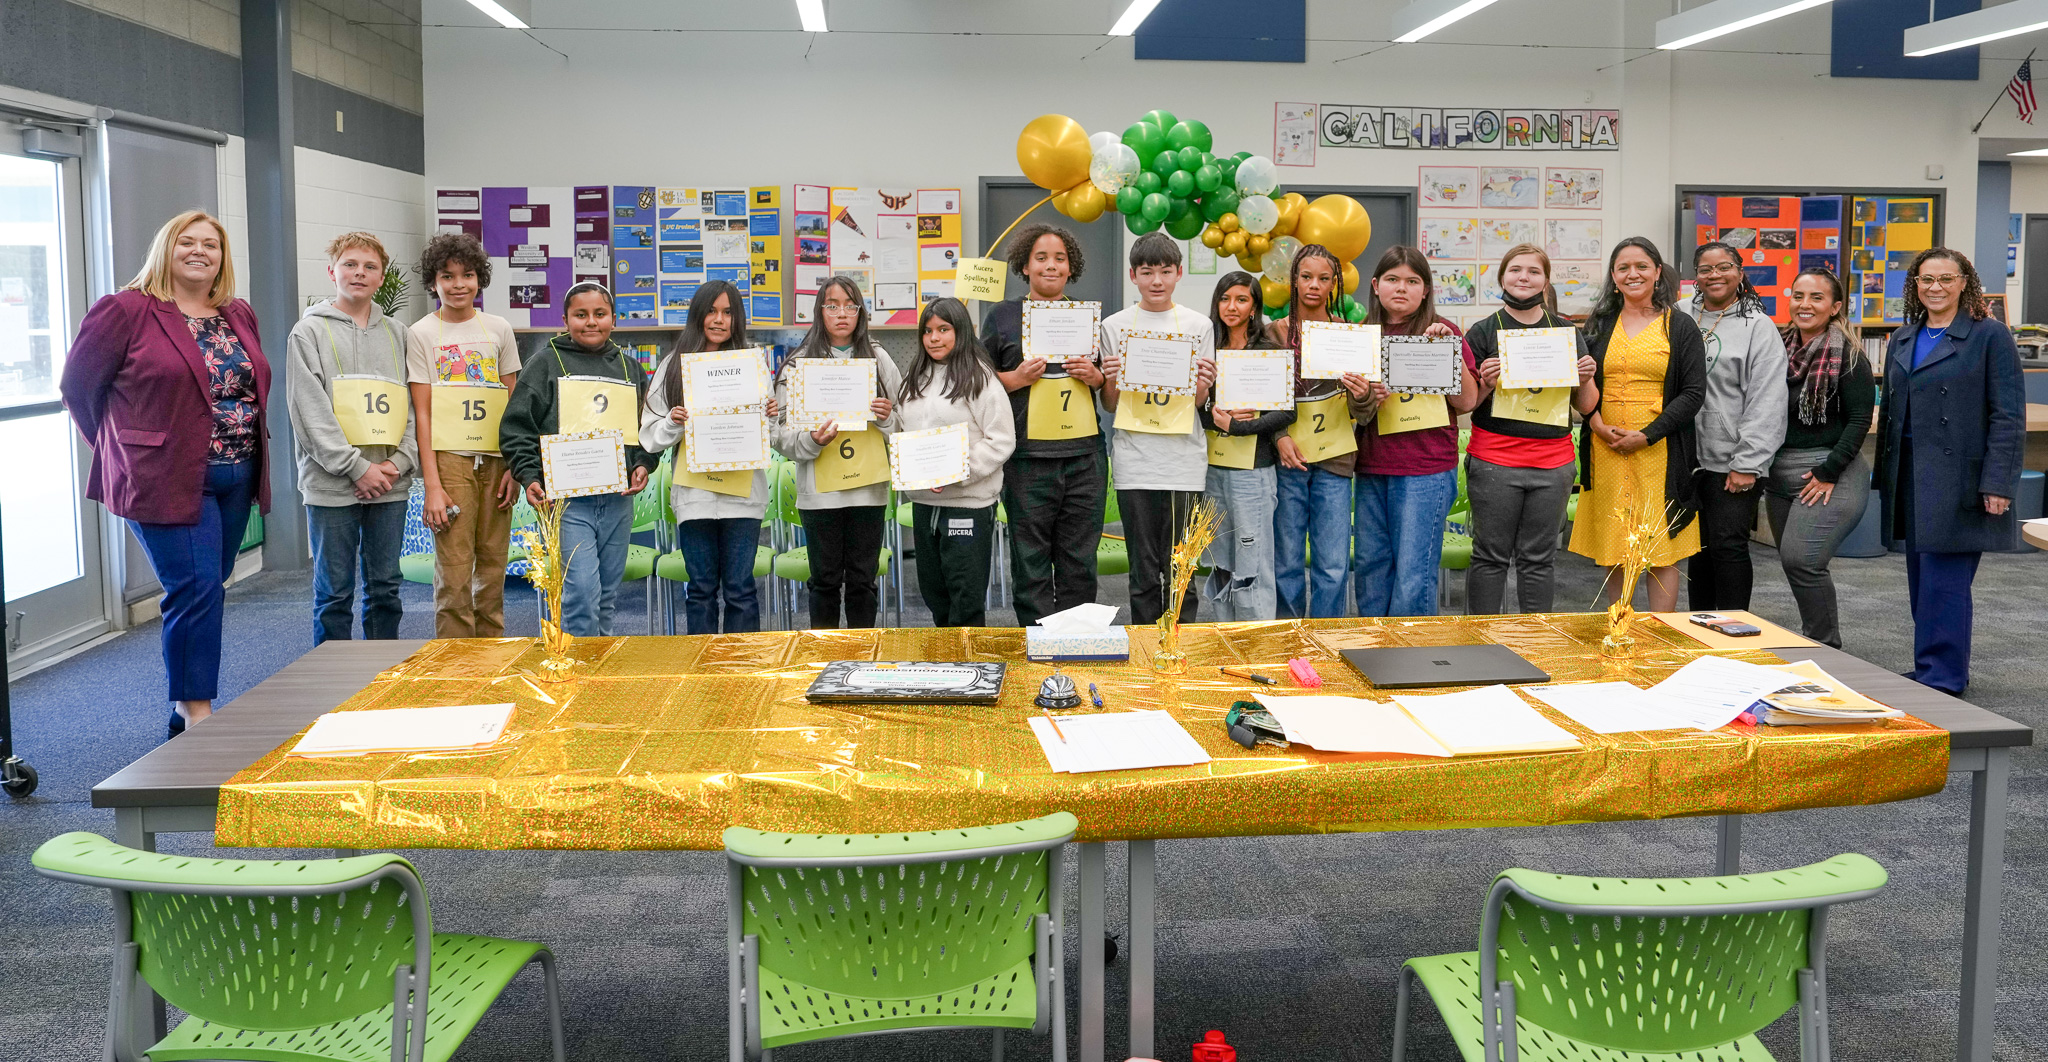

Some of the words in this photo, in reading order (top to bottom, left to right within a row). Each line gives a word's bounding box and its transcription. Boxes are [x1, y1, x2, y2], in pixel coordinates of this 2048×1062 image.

[1323, 110, 1618, 149] CALIFORNIA
[974, 264, 994, 272] Kucera
[964, 274, 988, 284] Spelling
[707, 368, 741, 377] WINNER
[364, 392, 390, 414] 16
[593, 394, 608, 414] 9
[1060, 390, 1072, 412] 7
[1144, 392, 1170, 406] 10
[462, 400, 486, 421] 15
[1312, 413, 1325, 434] 2
[840, 438, 855, 459] 6
